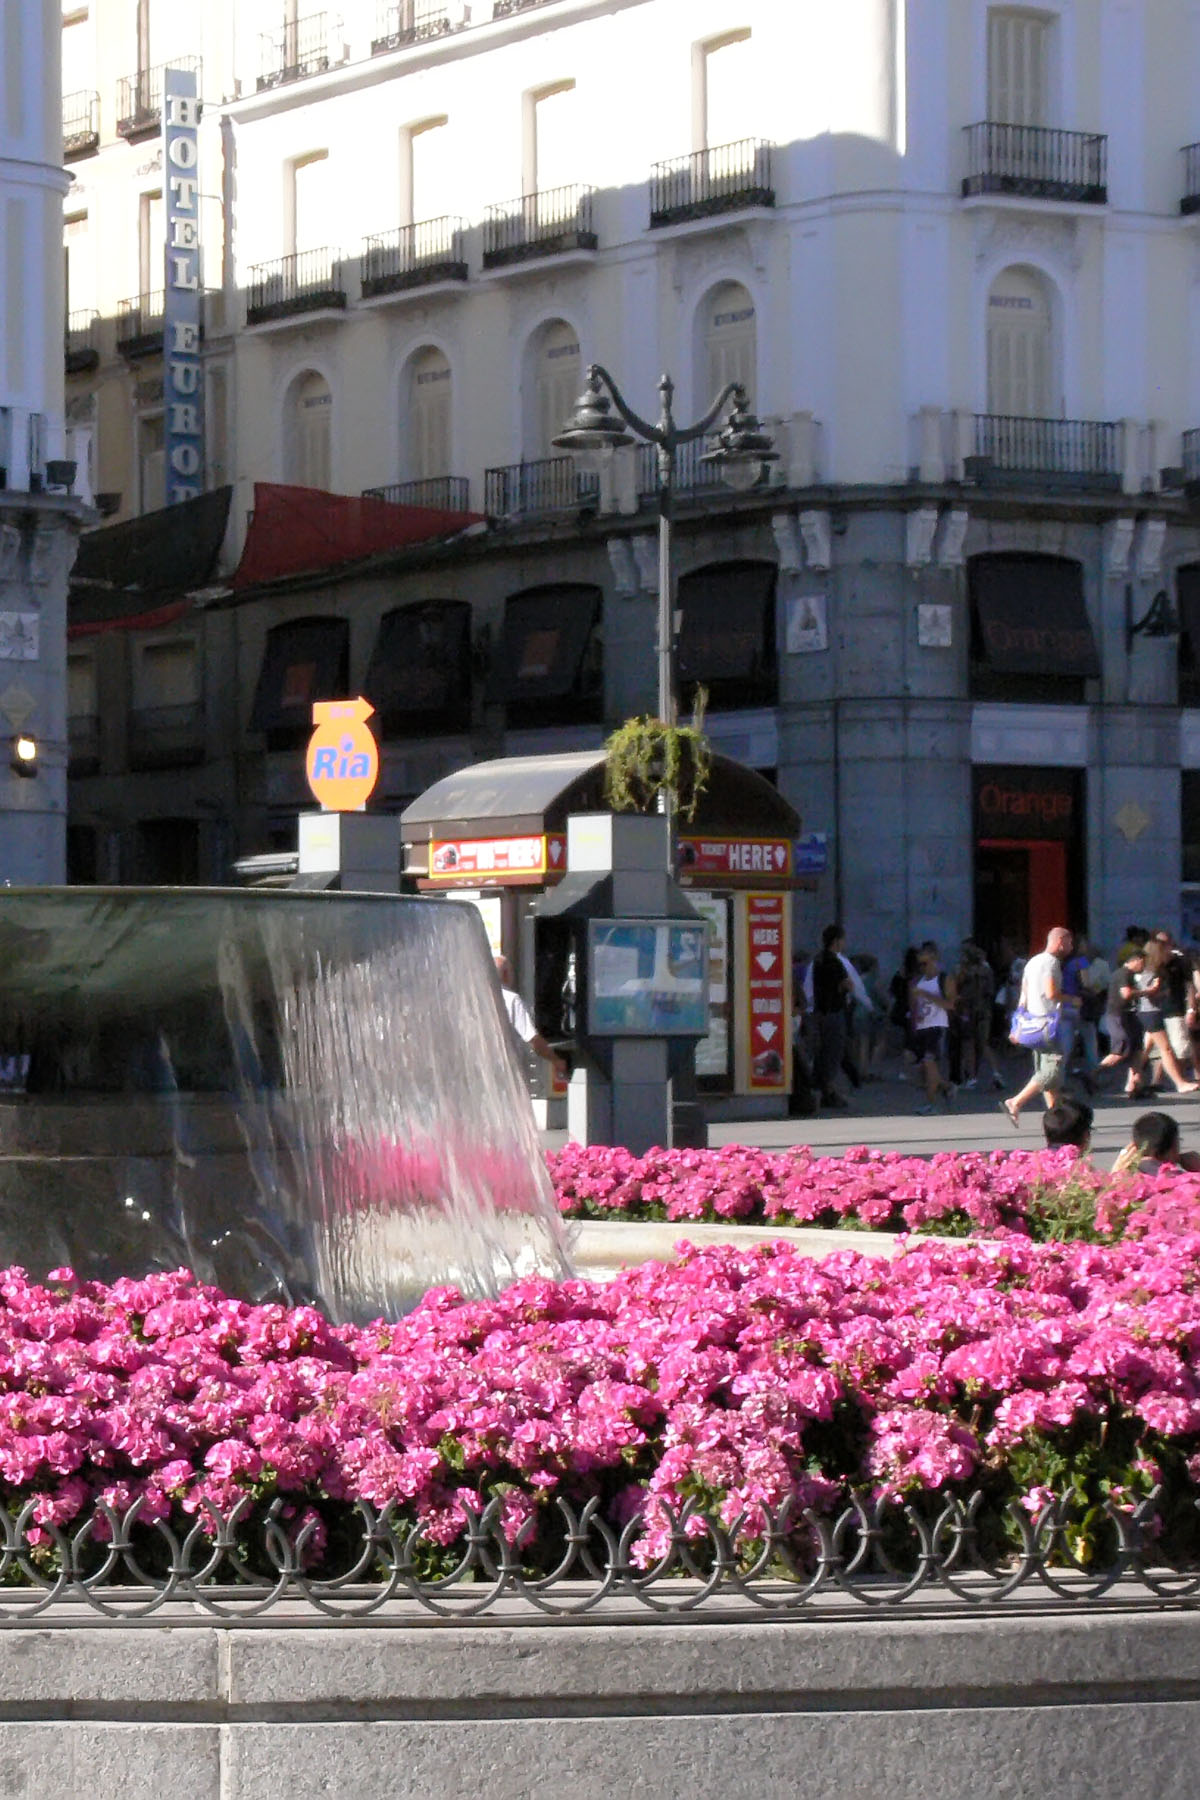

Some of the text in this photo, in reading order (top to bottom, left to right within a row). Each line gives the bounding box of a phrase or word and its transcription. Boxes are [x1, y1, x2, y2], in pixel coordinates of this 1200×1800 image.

[166, 94, 201, 290] HOTEL
[312, 738, 371, 779] Ria
[979, 784, 1073, 821] Orange
[729, 843, 773, 872] HERE
